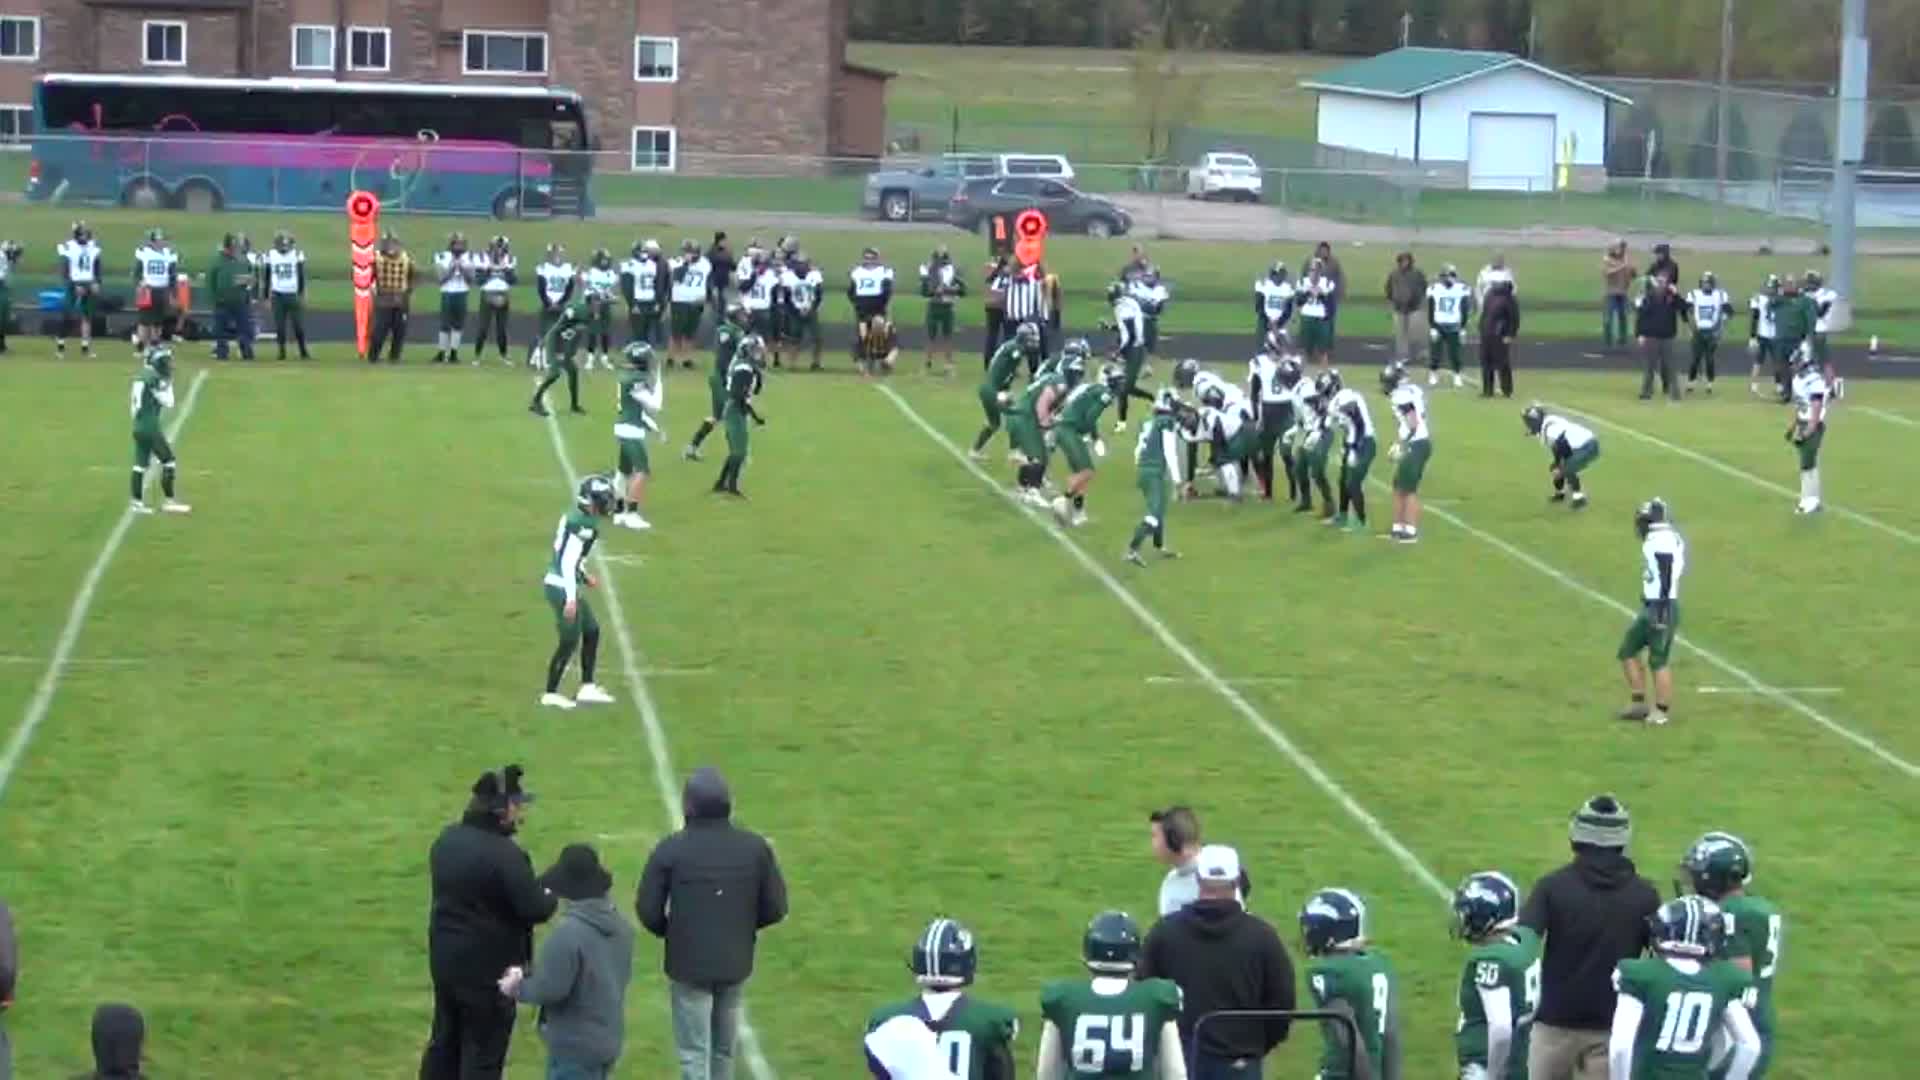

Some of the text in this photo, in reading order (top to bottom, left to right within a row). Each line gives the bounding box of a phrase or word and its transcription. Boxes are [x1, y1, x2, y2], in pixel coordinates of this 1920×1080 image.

[1475, 962, 1498, 984] 50
[1072, 1013, 1144, 1073] 64
[1656, 991, 1713, 1053] 10
[938, 1030, 971, 1080] 0
